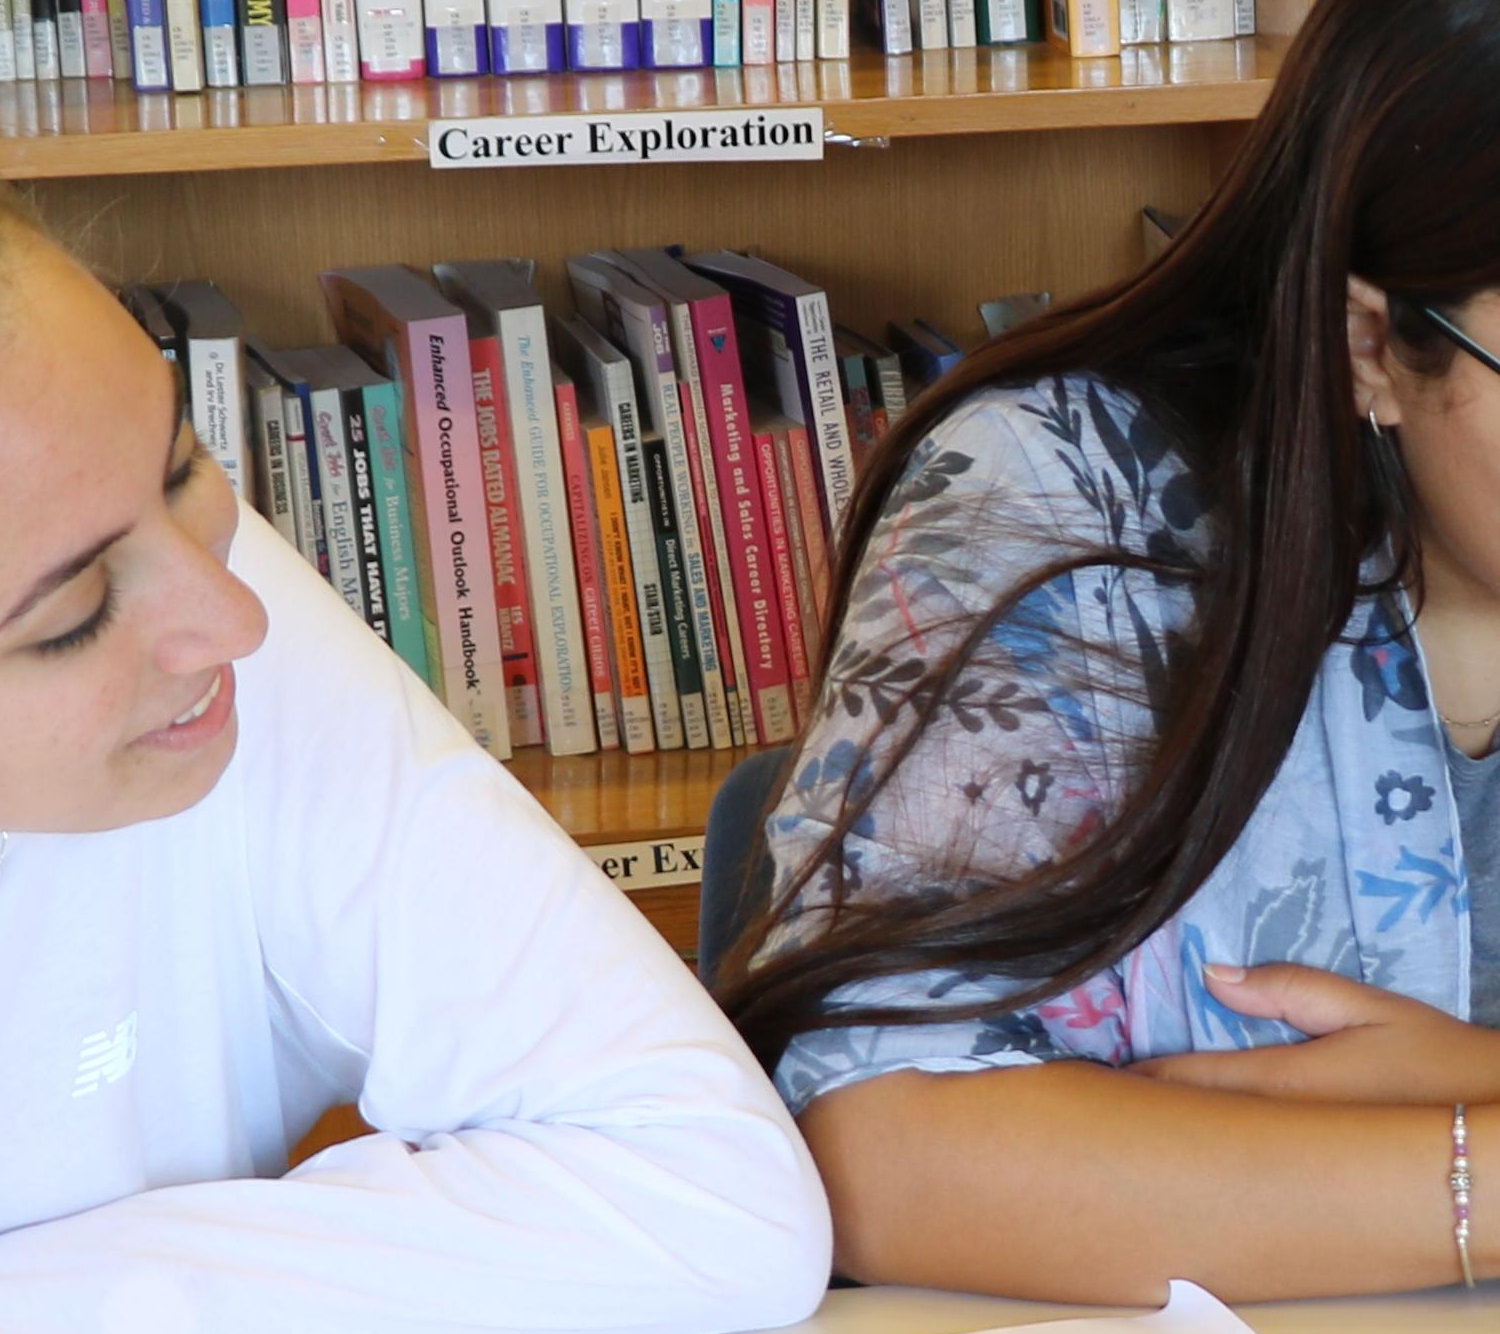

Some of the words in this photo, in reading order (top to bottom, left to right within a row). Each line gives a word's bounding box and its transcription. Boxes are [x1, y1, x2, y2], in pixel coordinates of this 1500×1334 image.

[437, 127, 572, 160] Career
[587, 116, 814, 159] Exploration
[429, 334, 451, 411] Enhanced
[517, 336, 533, 356] The
[472, 368, 493, 400] THE
[520, 360, 541, 421] Enhanced
[476, 406, 499, 447] JOBS
[528, 426, 546, 467] GUIDE
[435, 417, 463, 522] Occupational
[481, 450, 505, 502] RATED
[533, 473, 550, 497] FOR
[449, 531, 470, 597] Outlook
[489, 507, 515, 584] ALMANAC
[537, 502, 563, 600] OCCUPATIONAL
[456, 607, 480, 688] Handbook
[549, 605, 574, 694] EXPLORATION
